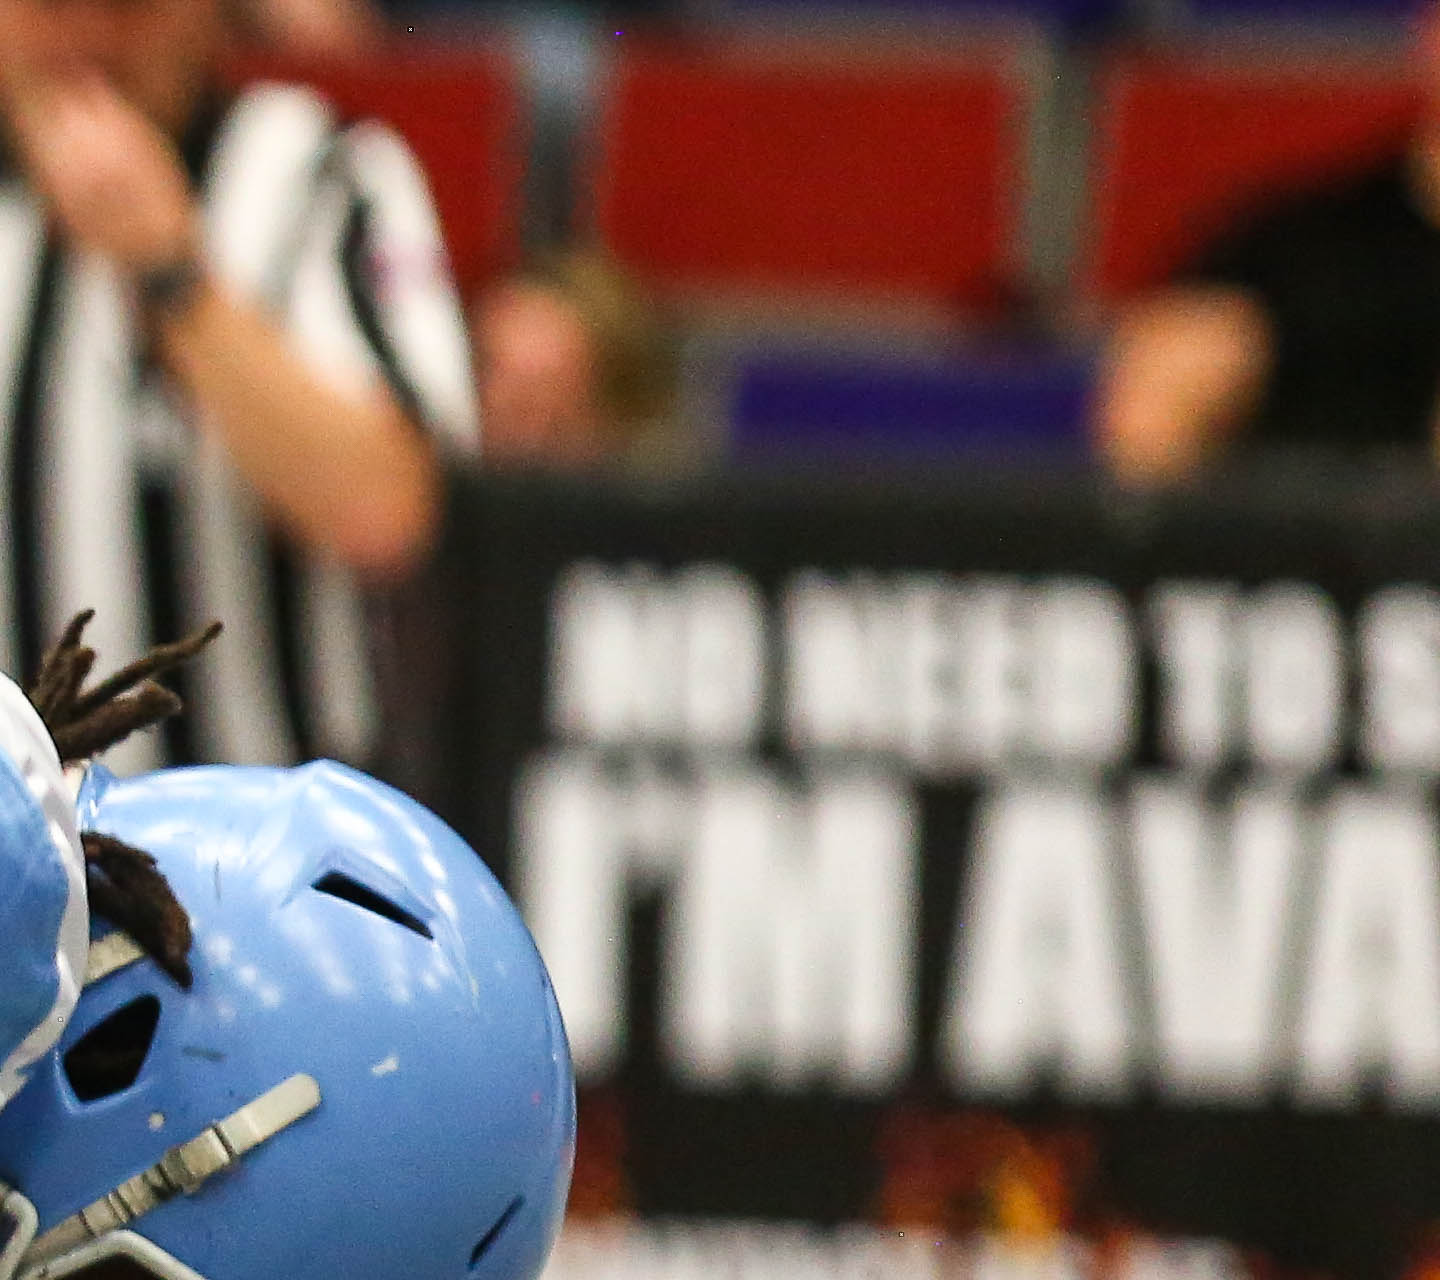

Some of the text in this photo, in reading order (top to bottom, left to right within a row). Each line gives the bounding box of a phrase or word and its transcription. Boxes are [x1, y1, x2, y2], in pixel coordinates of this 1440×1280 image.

[548, 558, 768, 750] NO
[780, 565, 1140, 765] NEED
[1148, 576, 1348, 772] TO
